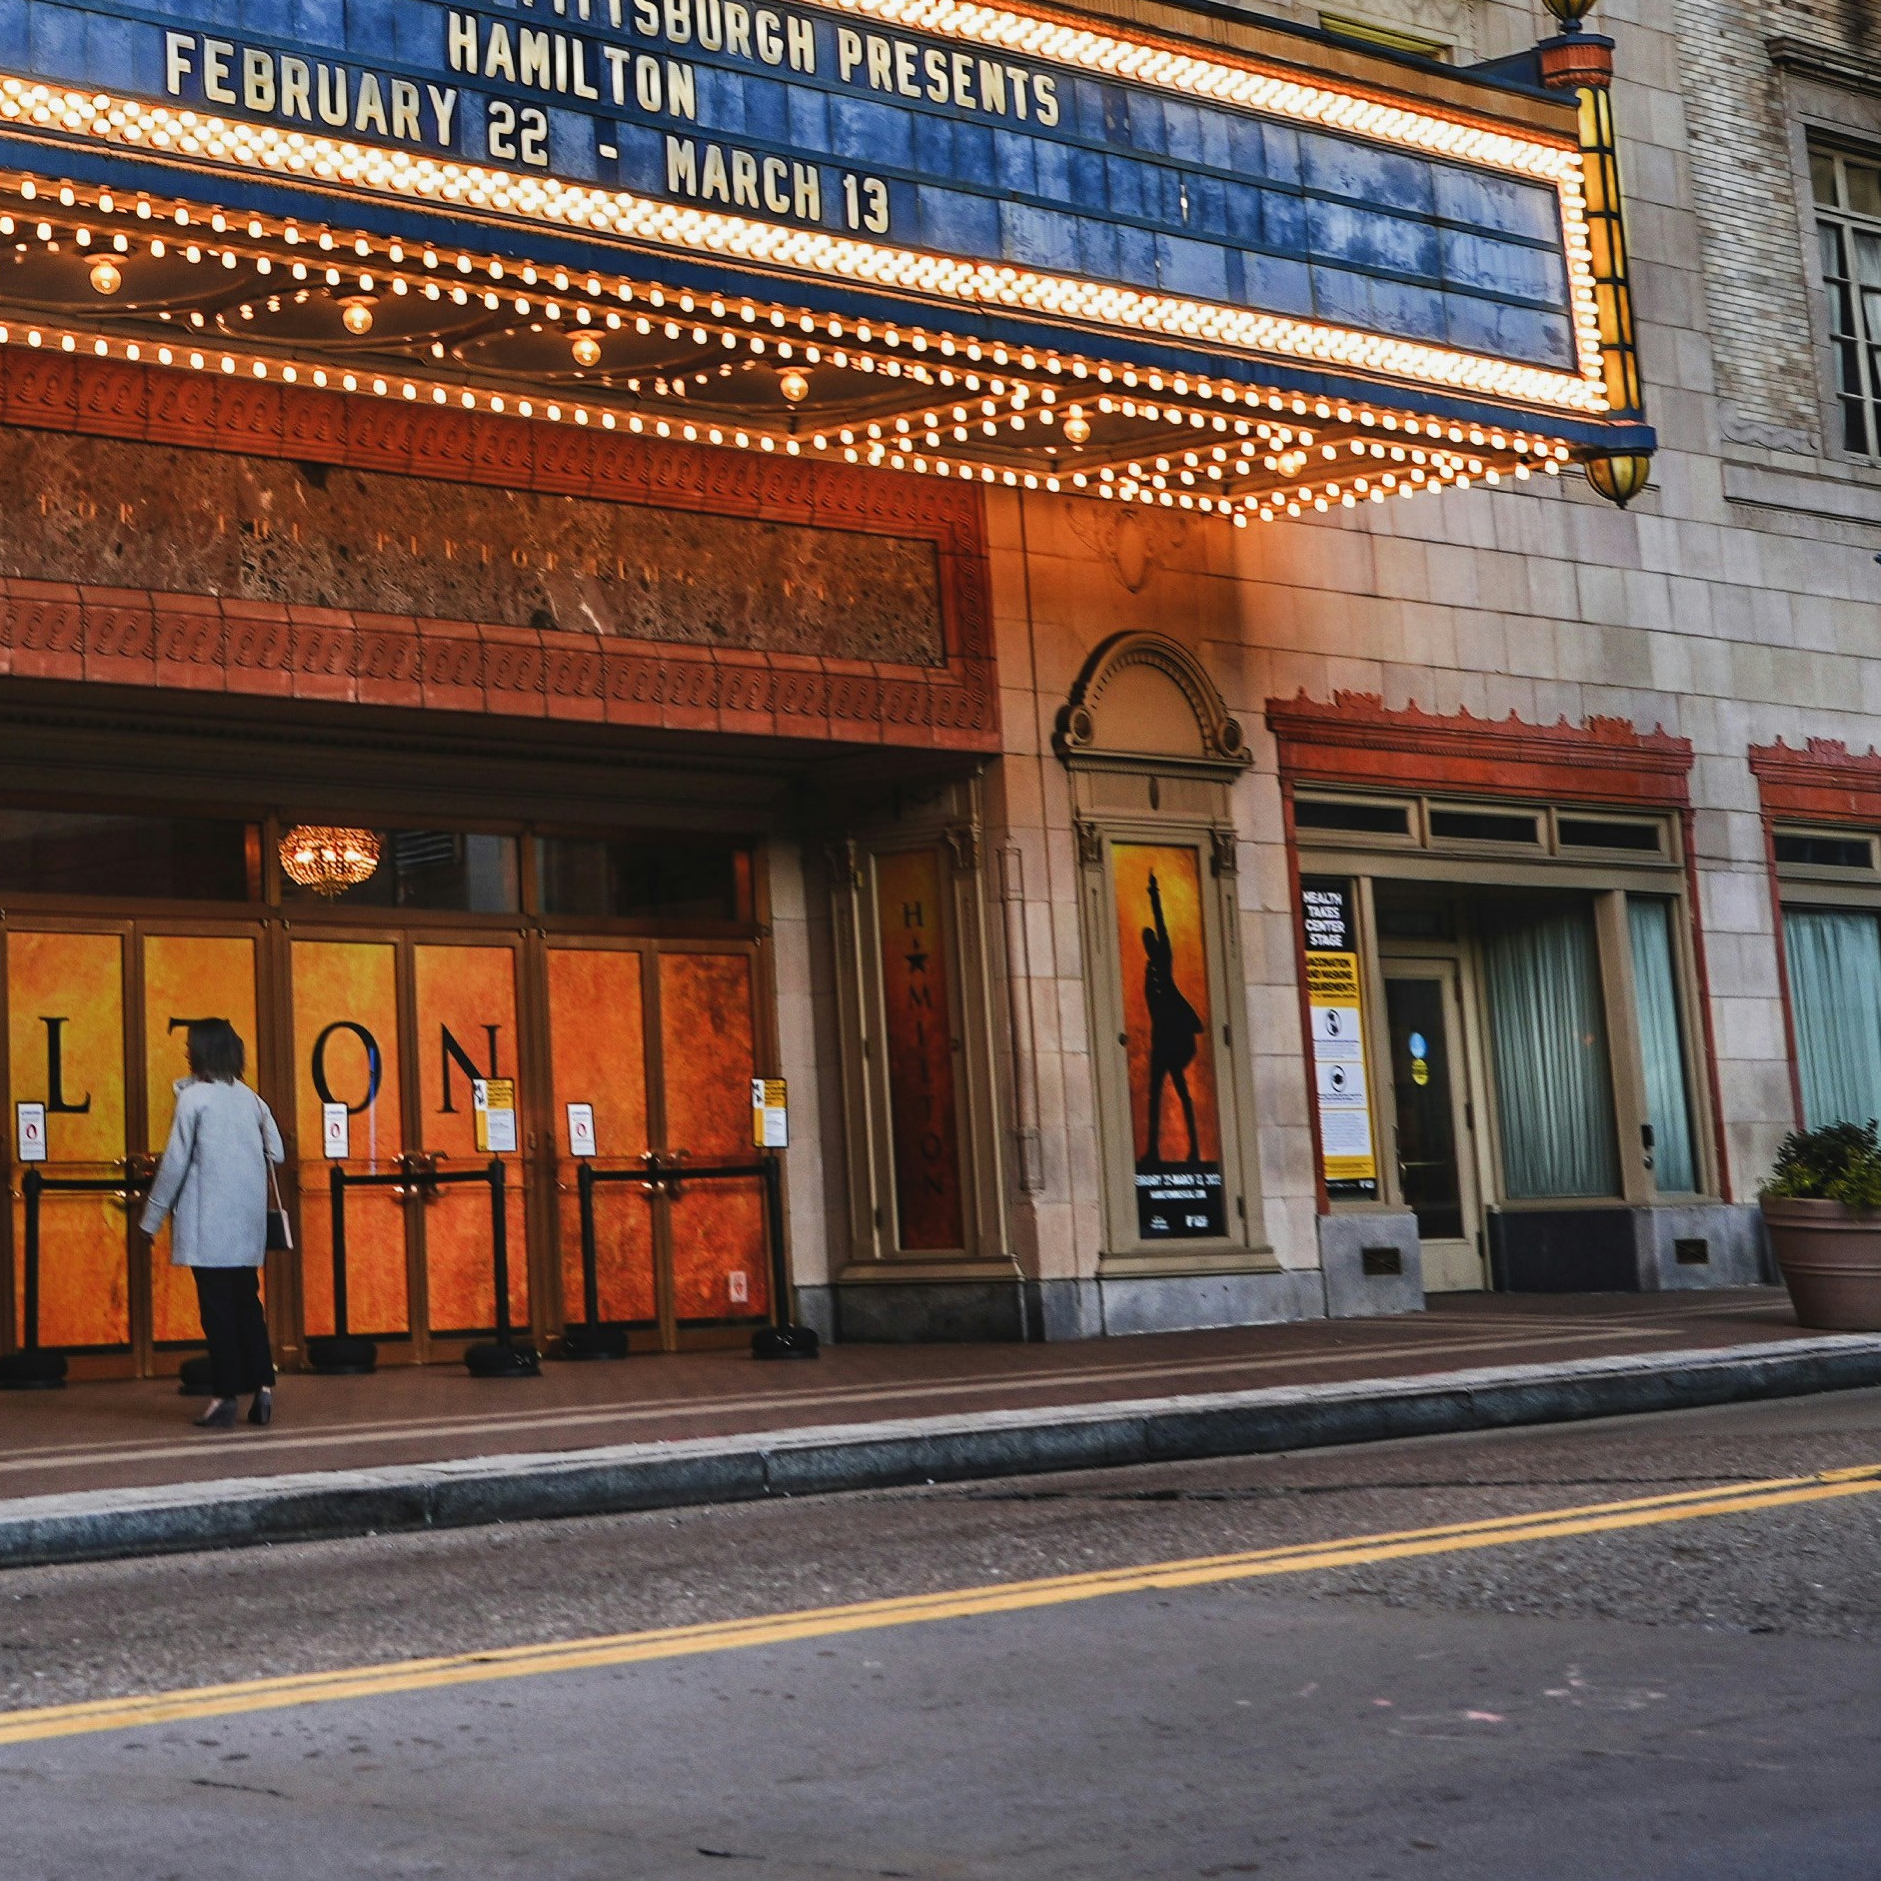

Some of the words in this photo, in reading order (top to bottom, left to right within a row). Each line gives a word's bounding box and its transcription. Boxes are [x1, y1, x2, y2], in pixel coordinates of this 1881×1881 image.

[447, 11, 698, 121] HAMILTON
[838, 27, 1060, 128] PRESENTS
[166, 30, 458, 147] FEBRUARY
[487, 100, 549, 167] 22
[598, 141, 619, 160] -
[665, 135, 822, 222] MARCH
[842, 171, 890, 235] 13
[1302, 890, 1343, 906] HEALTH
[1306, 905, 1341, 919] TAKES
[1304, 919, 1346, 934] CENTER
[1309, 933, 1344, 948] STAGE
